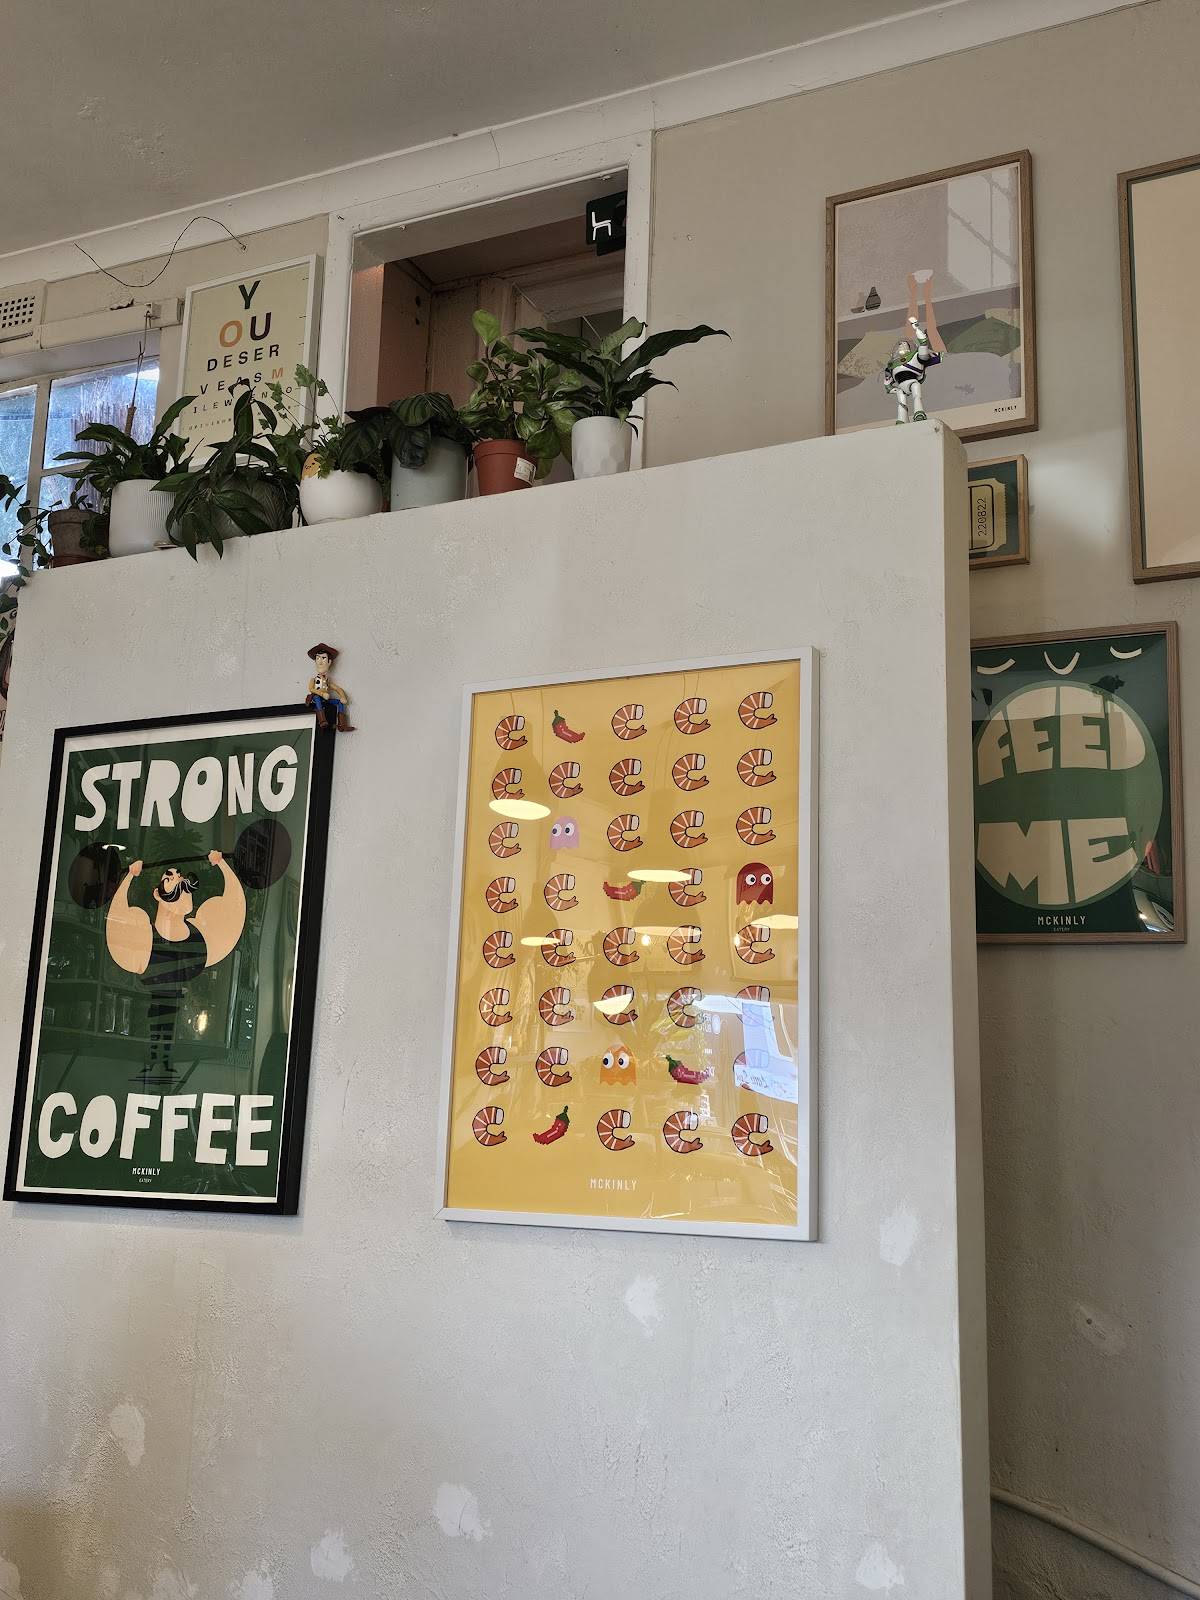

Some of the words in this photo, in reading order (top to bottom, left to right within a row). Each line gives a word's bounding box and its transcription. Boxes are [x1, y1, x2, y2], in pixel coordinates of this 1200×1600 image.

[238, 280, 261, 310] Y
[219, 311, 272, 348] OU
[207, 344, 280, 372] DESER
[978, 686, 1146, 786] FEED
[74, 745, 299, 832] STRONG
[977, 817, 1139, 905] ME
[1037, 915, 1086, 926] MCKINLY
[38, 1092, 274, 1166] COFFEE
[132, 1167, 161, 1176] MCKINLY
[589, 1178, 637, 1191] MCKINLY
